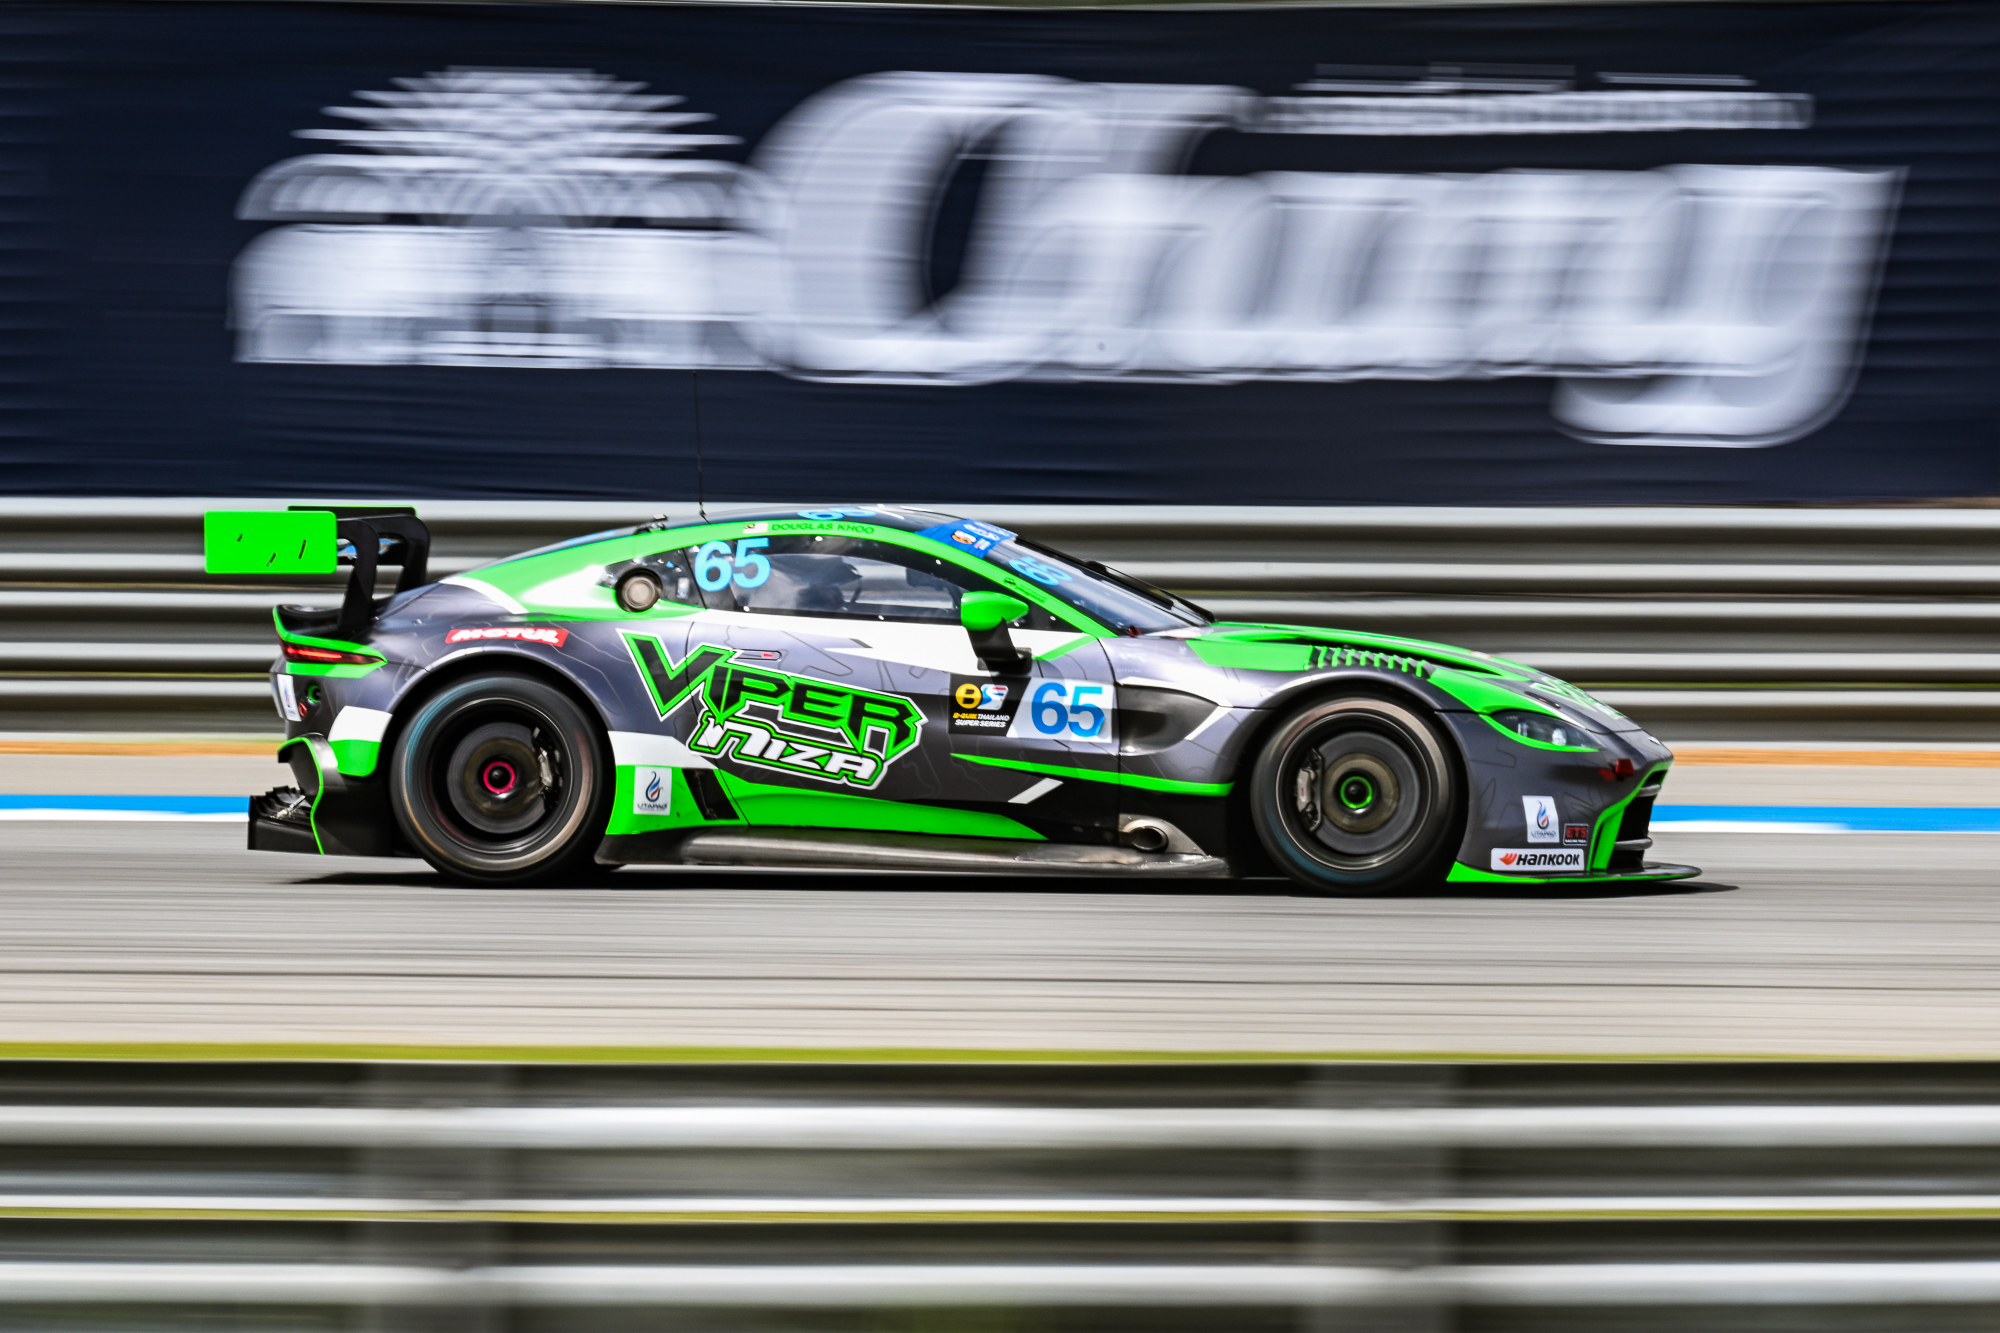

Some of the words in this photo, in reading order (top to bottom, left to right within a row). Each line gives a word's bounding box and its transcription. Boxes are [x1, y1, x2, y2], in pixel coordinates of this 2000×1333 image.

[771, 523, 834, 532] DOUGLAS
[837, 524, 875, 535] KHOO
[694, 537, 771, 592] 65
[1008, 556, 1073, 586] 65
[451, 628, 559, 643] MOTUL
[616, 628, 929, 760] VIPER
[978, 713, 1010, 721] THAILAND
[1031, 682, 1105, 738] 65
[980, 720, 1006, 728] SERIES
[1566, 826, 1587, 838] ETS
